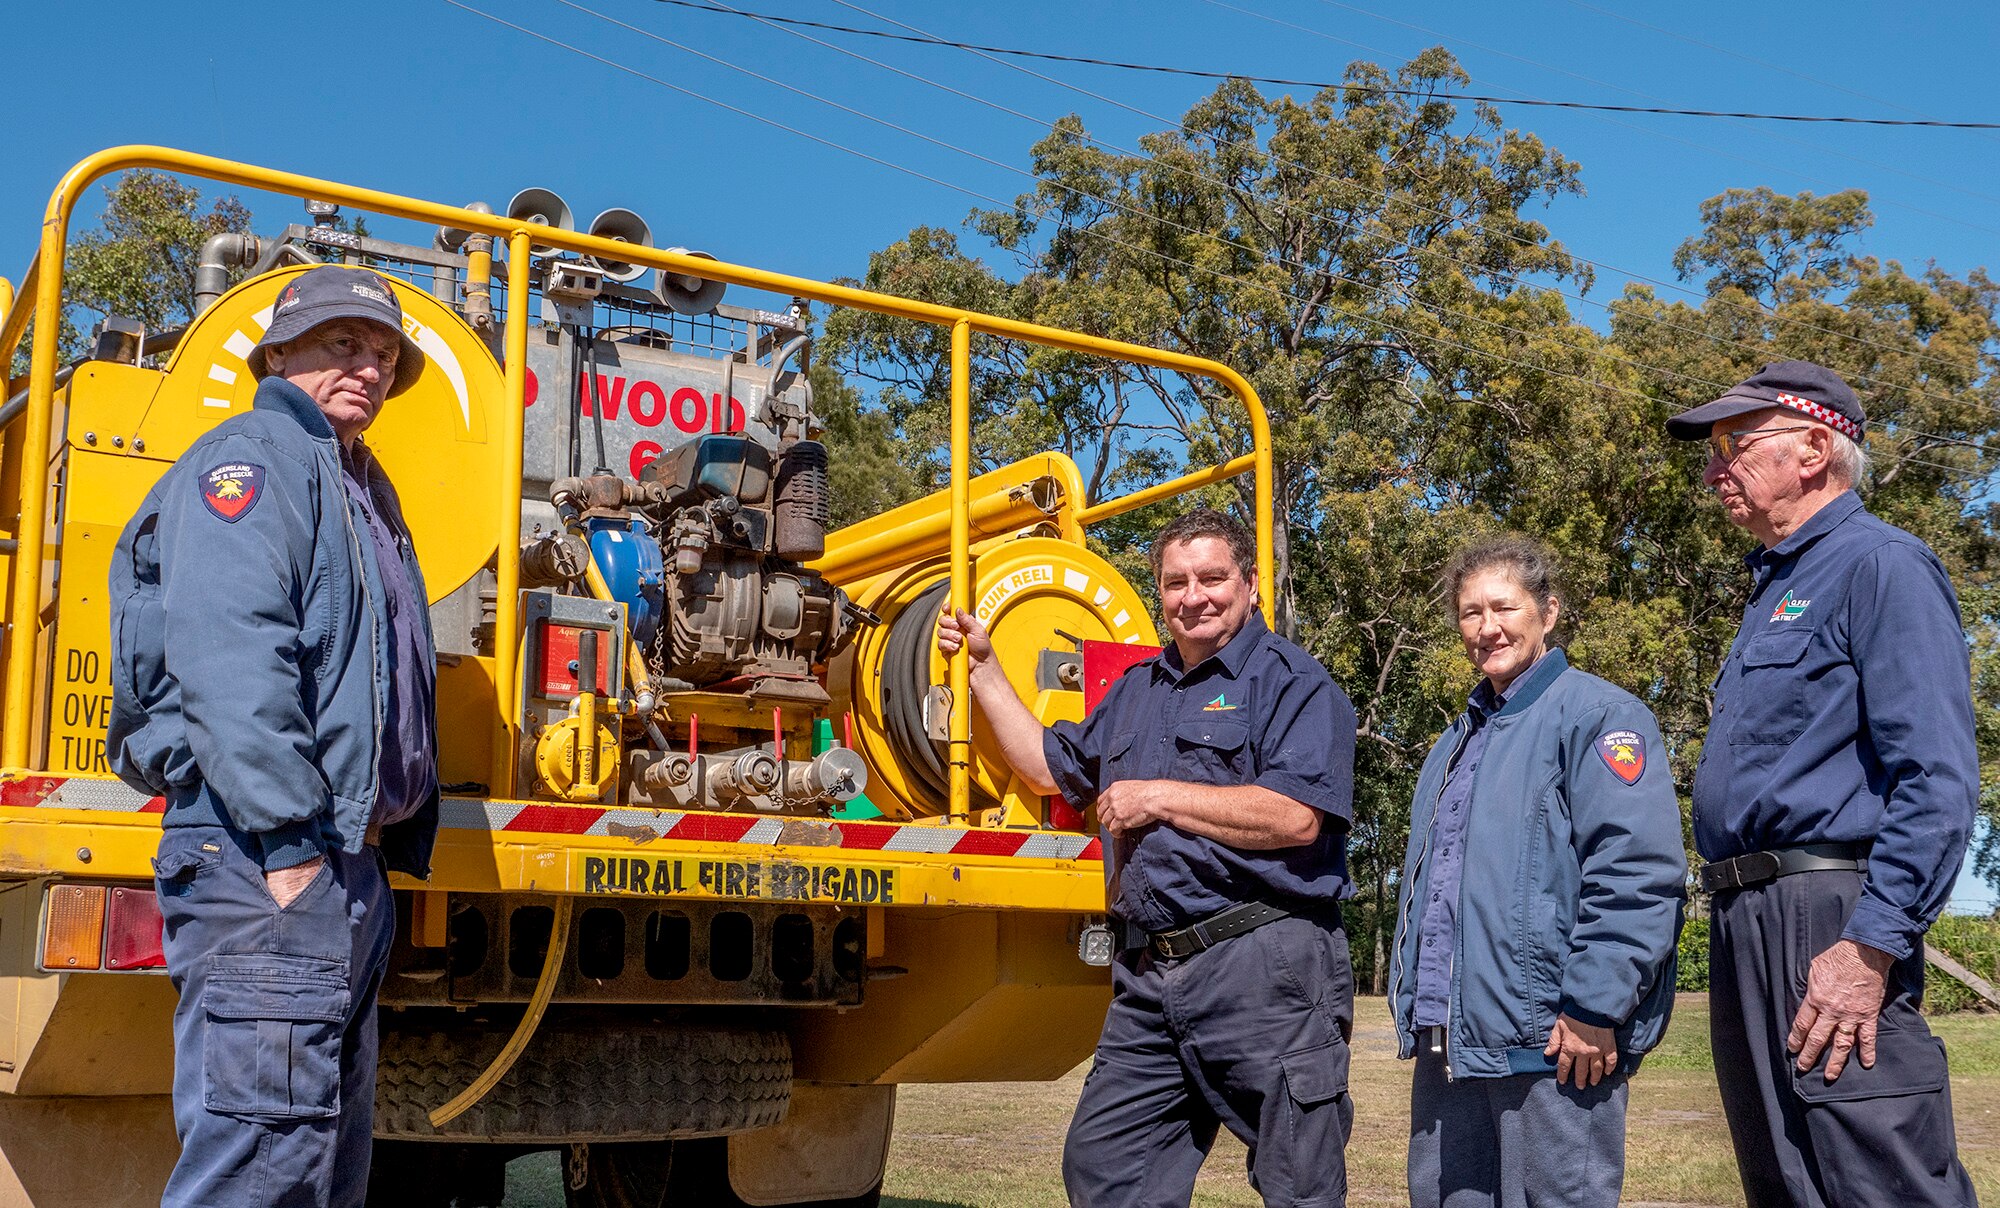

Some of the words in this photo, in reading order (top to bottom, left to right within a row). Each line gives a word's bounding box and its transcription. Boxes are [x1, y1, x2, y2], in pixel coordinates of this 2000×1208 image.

[402, 317, 421, 342] EL
[581, 371, 746, 436] WOOD
[209, 474, 222, 483] FIRE
[229, 471, 254, 479] RESCUE
[211, 465, 251, 477] QUEENSLAND
[978, 582, 1010, 620] QUIK
[1011, 568, 1051, 589] REEL
[66, 648, 99, 685] DO
[63, 693, 113, 729] OVE
[61, 736, 109, 773] TUR
[585, 856, 688, 895] RURAL
[699, 862, 762, 897] FIRE
[770, 864, 894, 903] BRIGADE
